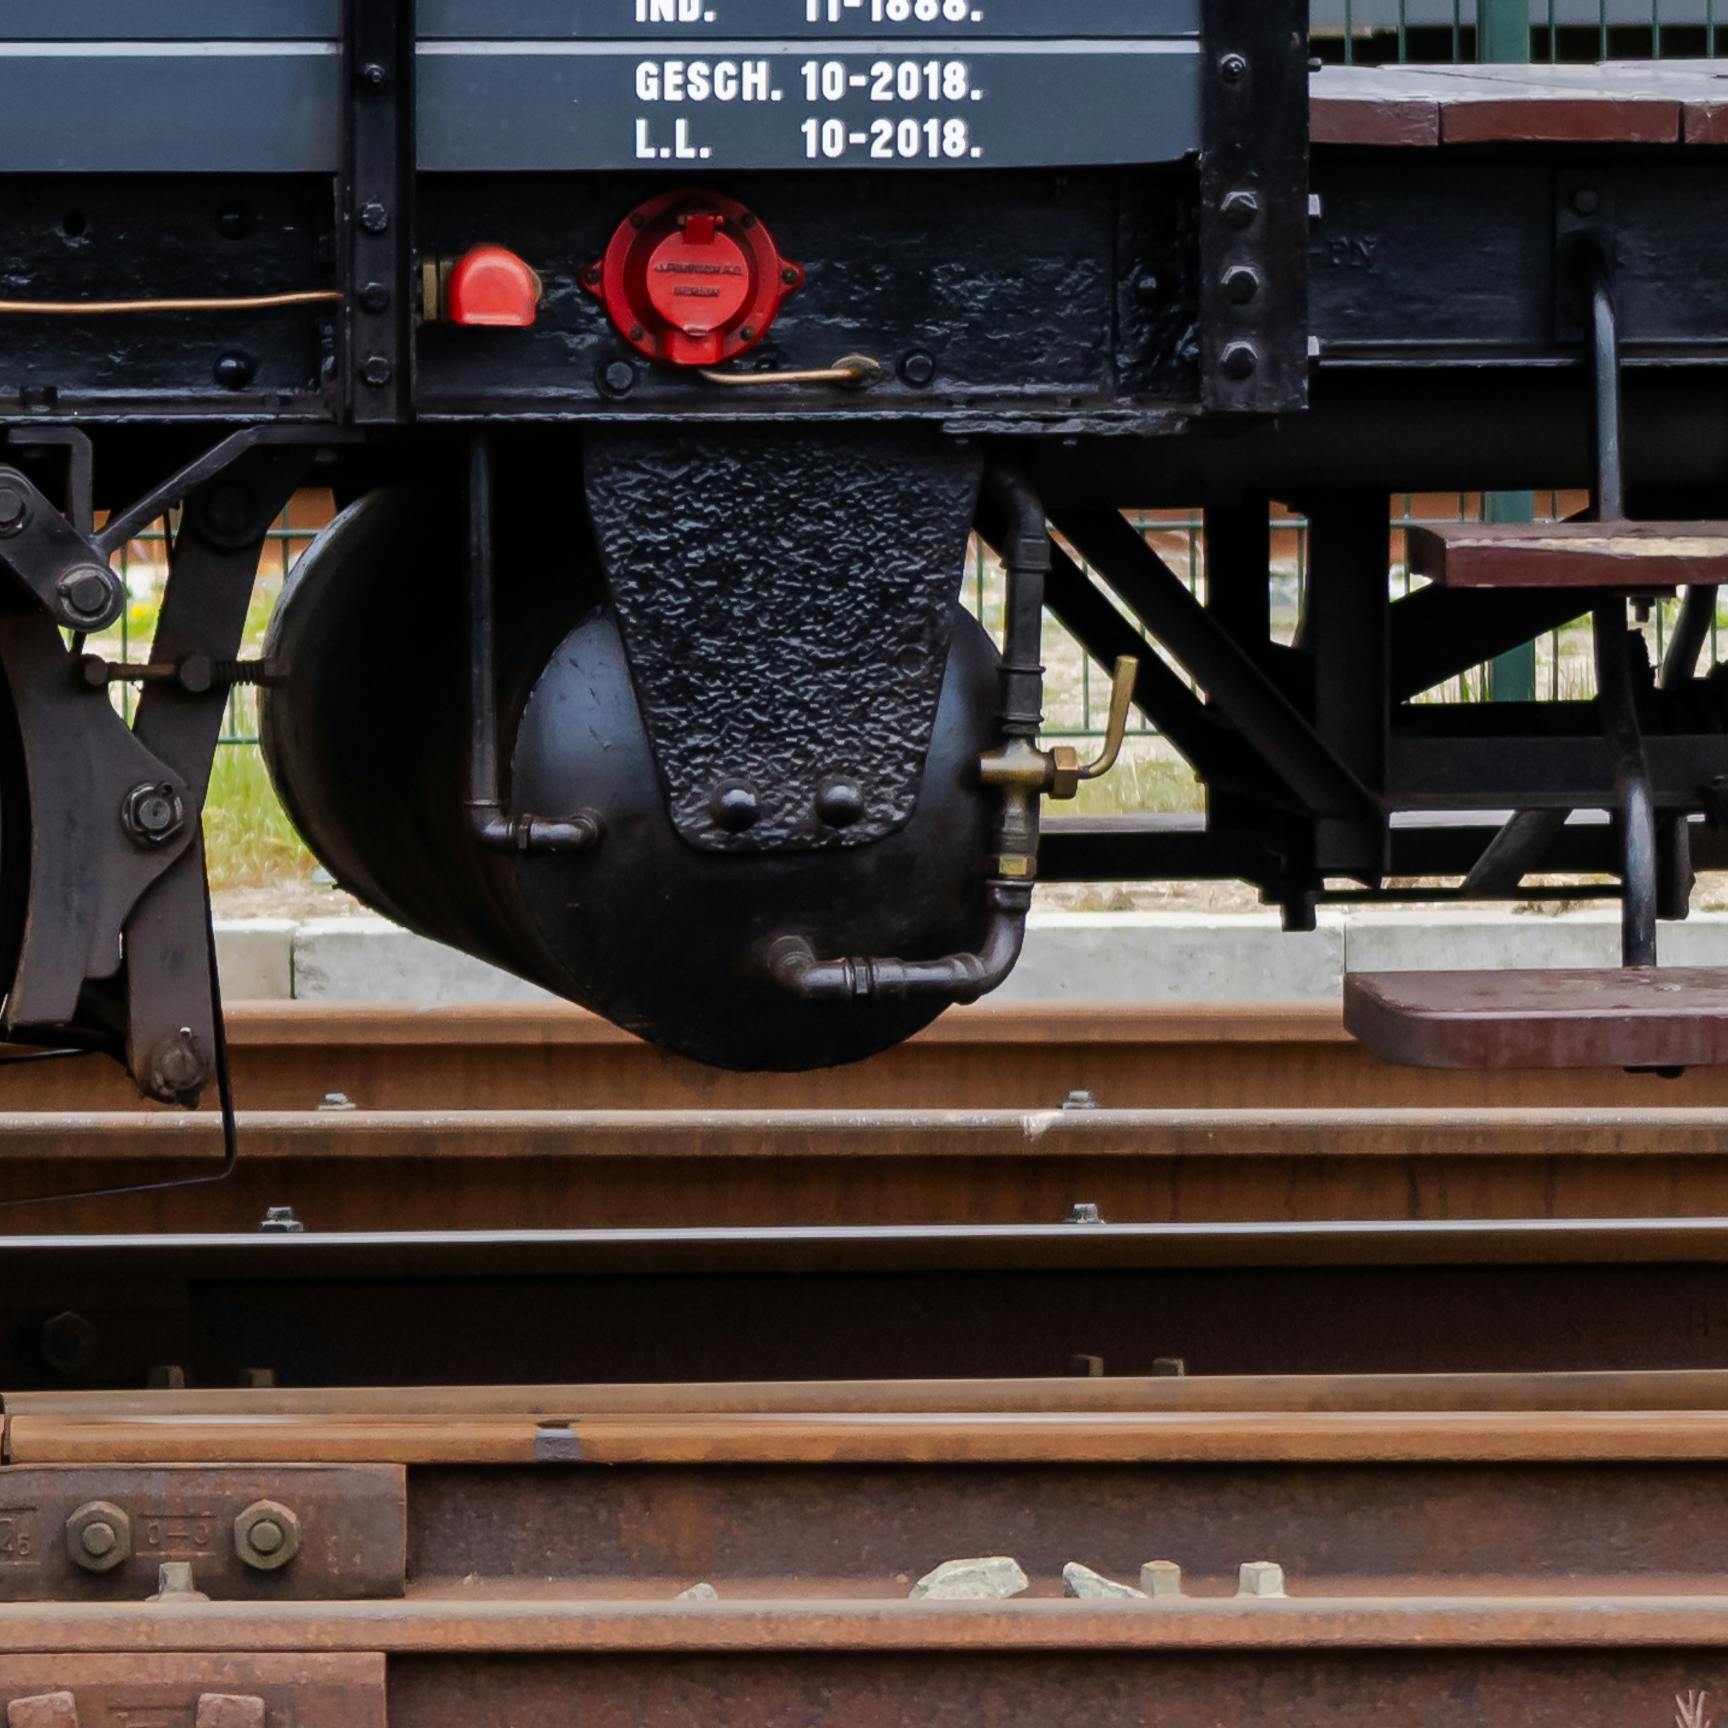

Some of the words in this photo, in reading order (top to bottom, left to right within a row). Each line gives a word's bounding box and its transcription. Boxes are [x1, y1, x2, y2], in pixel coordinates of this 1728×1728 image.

[636, 61, 782, 101] GESCH.
[800, 61, 982, 101] 10-2018.
[636, 119, 711, 158] L.L.
[800, 118, 982, 158] 10-2018.
